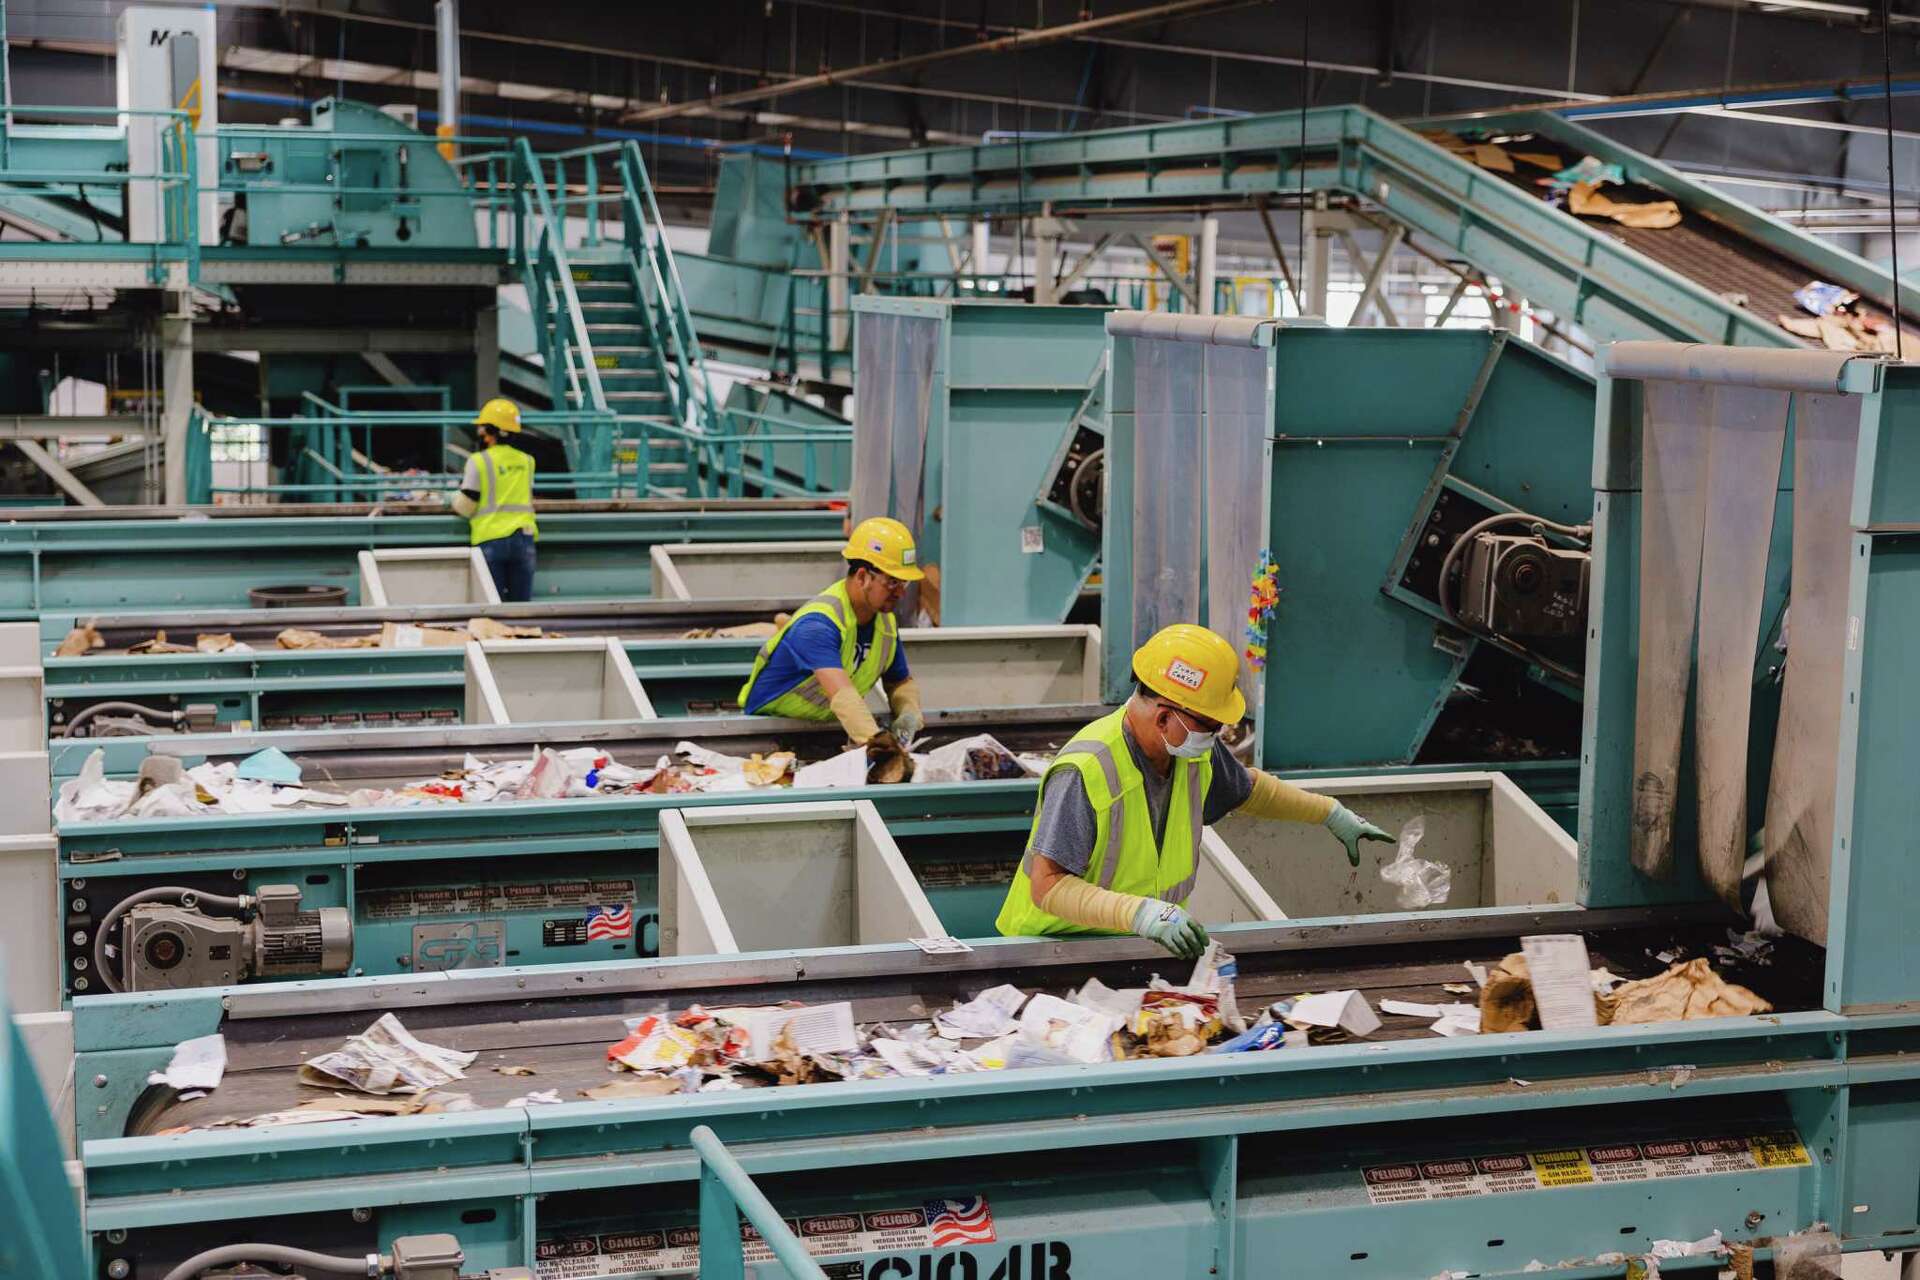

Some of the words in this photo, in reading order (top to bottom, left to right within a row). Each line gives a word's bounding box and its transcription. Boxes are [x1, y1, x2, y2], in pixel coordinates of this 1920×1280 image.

[1596, 1149, 1633, 1159] DANGER
[1649, 1144, 1687, 1155] DANGER
[1536, 1151, 1579, 1162] CUIDADO
[1428, 1164, 1468, 1174] PELIGRO
[1484, 1159, 1523, 1170] PELIGRO
[1372, 1169, 1412, 1179] PELIGRO
[809, 1219, 855, 1231] PELIGRO
[872, 1214, 917, 1226] PELIGRO
[609, 1235, 655, 1248] DANGER
[541, 1241, 588, 1256] DAER
[609, 1263, 664, 1274] AUTOMATICALLY
